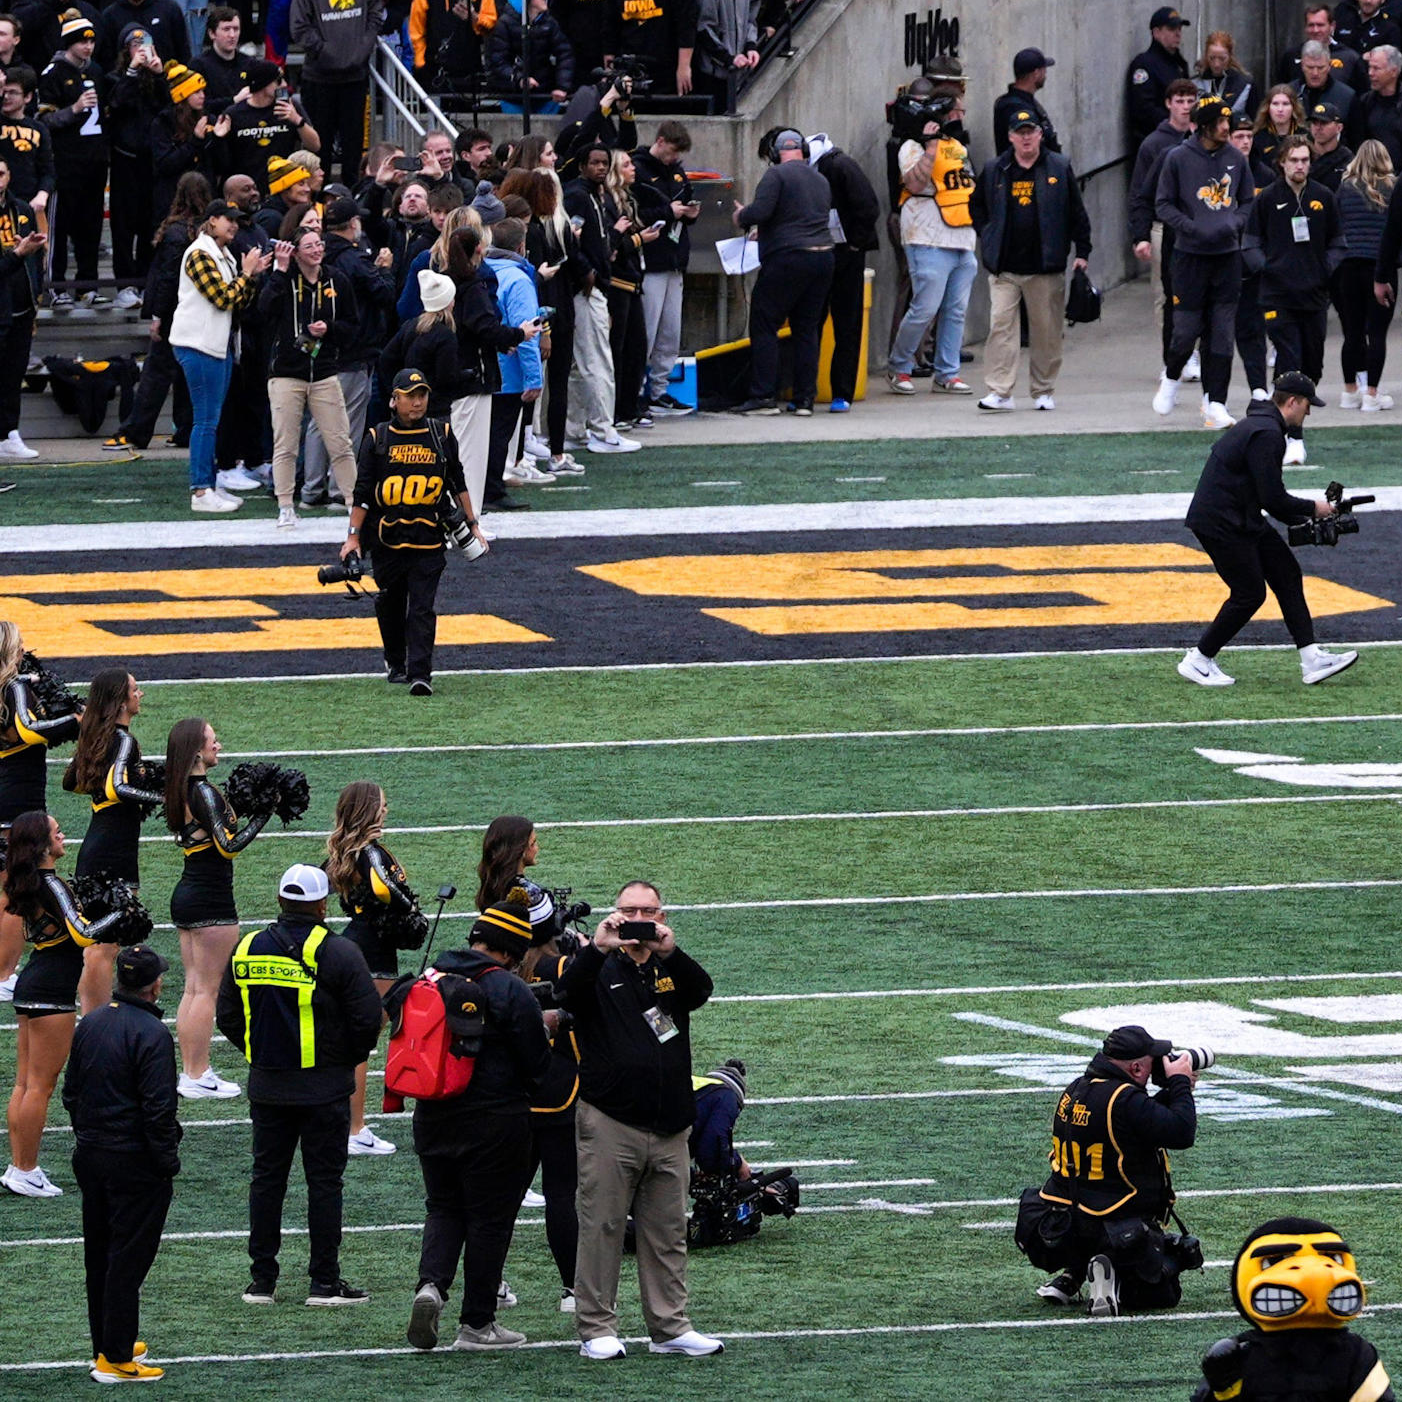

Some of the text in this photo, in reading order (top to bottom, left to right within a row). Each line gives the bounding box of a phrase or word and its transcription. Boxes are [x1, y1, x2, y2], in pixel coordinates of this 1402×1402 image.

[79, 105, 103, 136] 2
[236, 124, 289, 138] FOOTBALL
[390, 445, 422, 457] FIGHT
[404, 453, 437, 465] IOWA
[381, 476, 443, 506] 002
[250, 966, 267, 976] CBS
